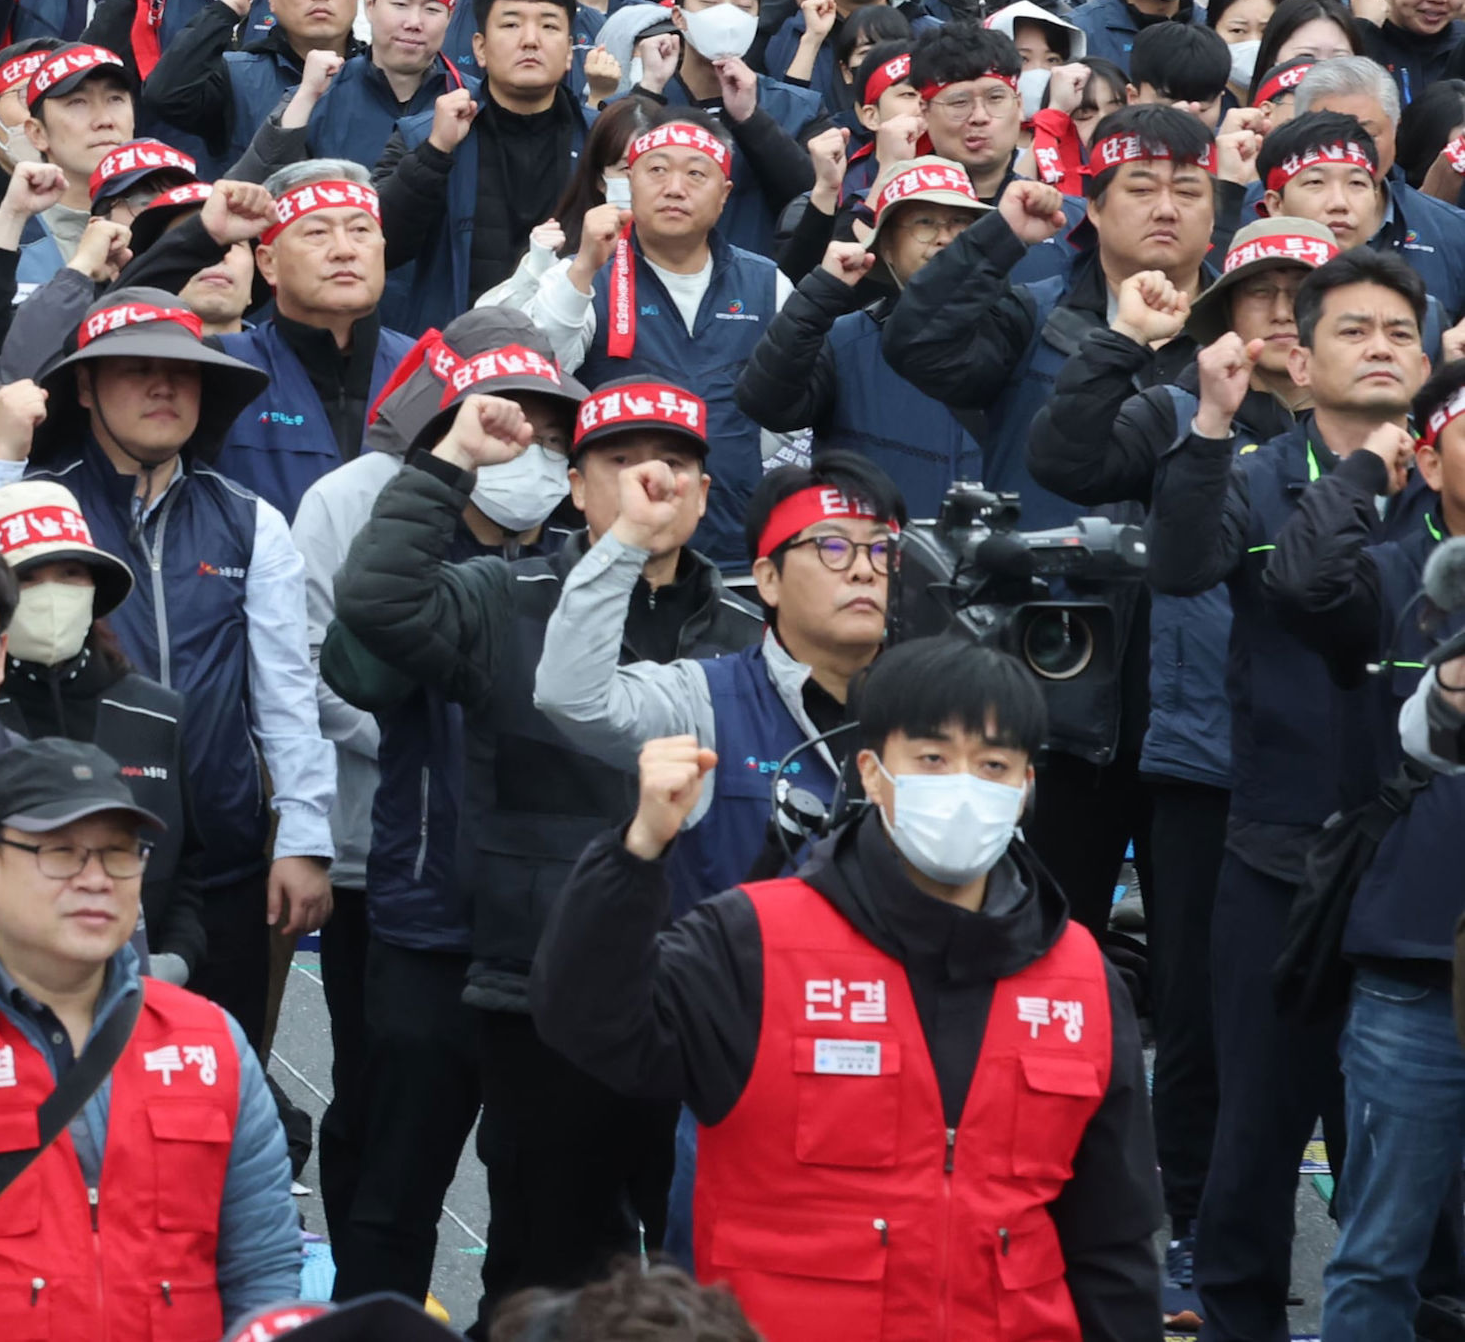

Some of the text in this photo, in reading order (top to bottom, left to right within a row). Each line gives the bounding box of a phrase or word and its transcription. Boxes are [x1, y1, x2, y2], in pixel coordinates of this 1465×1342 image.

[805, 978, 1086, 1045] 단결 투쟁
[142, 1043, 218, 1086] 투쟁
